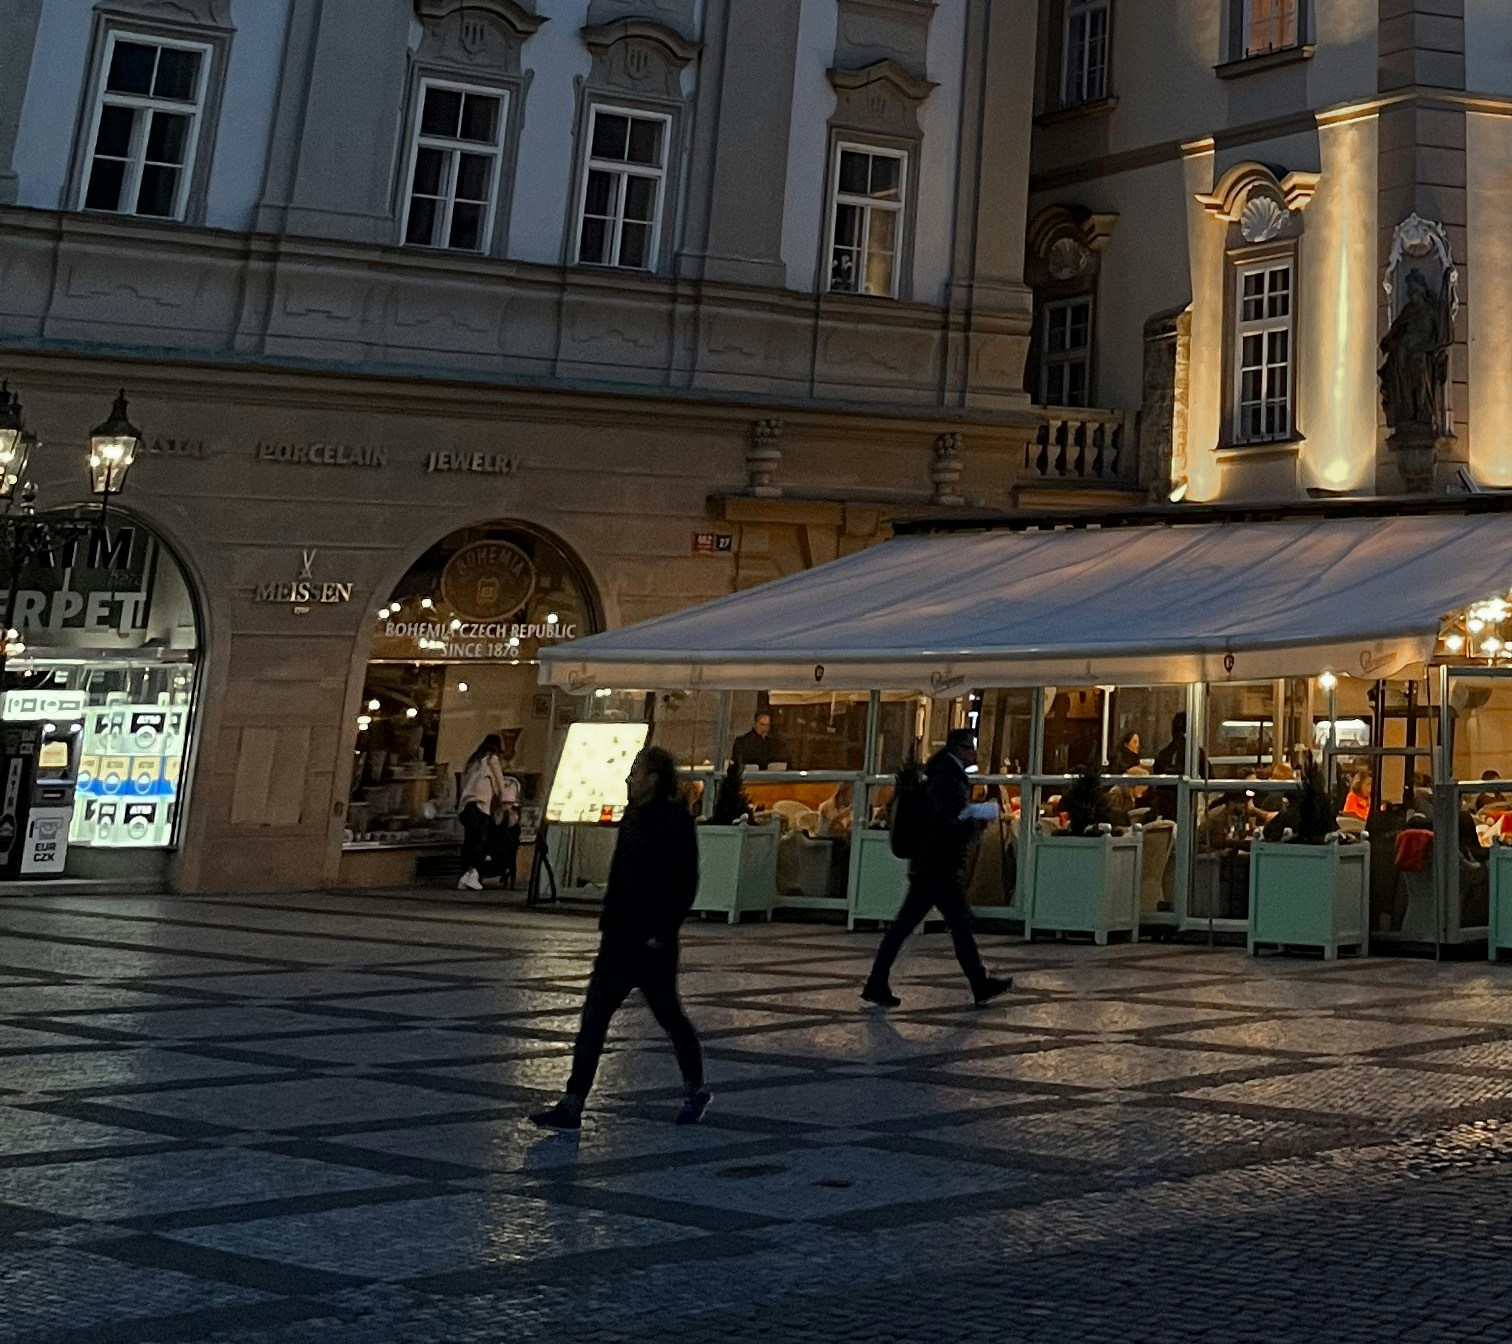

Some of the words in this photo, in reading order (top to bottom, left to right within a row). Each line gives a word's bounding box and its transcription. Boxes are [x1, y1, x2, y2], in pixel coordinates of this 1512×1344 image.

[258, 441, 387, 467] PORCELAIN
[426, 450, 519, 474] JEWELRY
[719, 537, 731, 549] 27
[255, 582, 353, 602] MEISSEN
[385, 622, 454, 638] BOHEMIA
[459, 623, 506, 638] CZECH
[512, 623, 577, 639] REPUBLIC
[441, 642, 482, 658] SINCE
[487, 642, 519, 658] 1876
[35, 842, 57, 852] EUR
[33, 853, 55, 862] CZK
